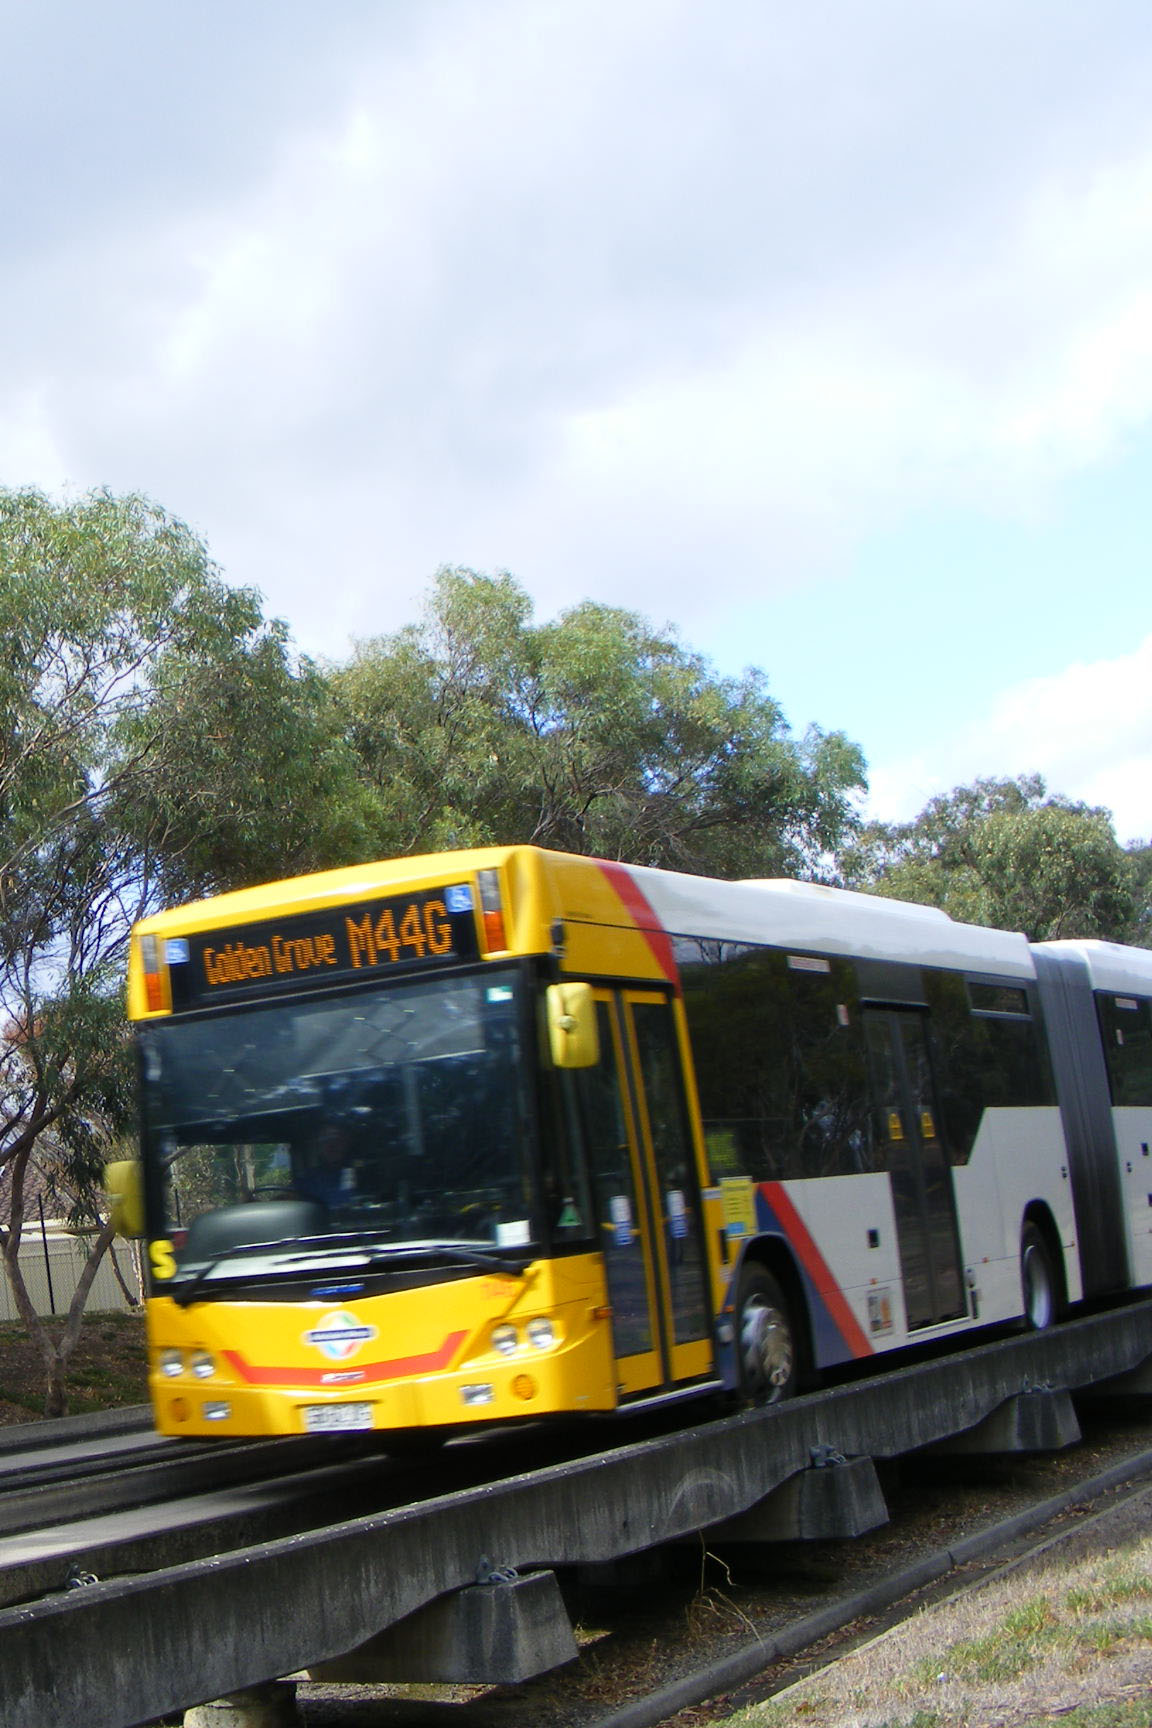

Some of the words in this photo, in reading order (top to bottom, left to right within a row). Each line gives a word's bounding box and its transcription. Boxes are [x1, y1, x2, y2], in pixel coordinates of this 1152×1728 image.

[203, 942, 272, 985] Golden
[271, 934, 337, 973] Grove
[345, 900, 452, 968] M44G
[149, 1239, 176, 1279] S
